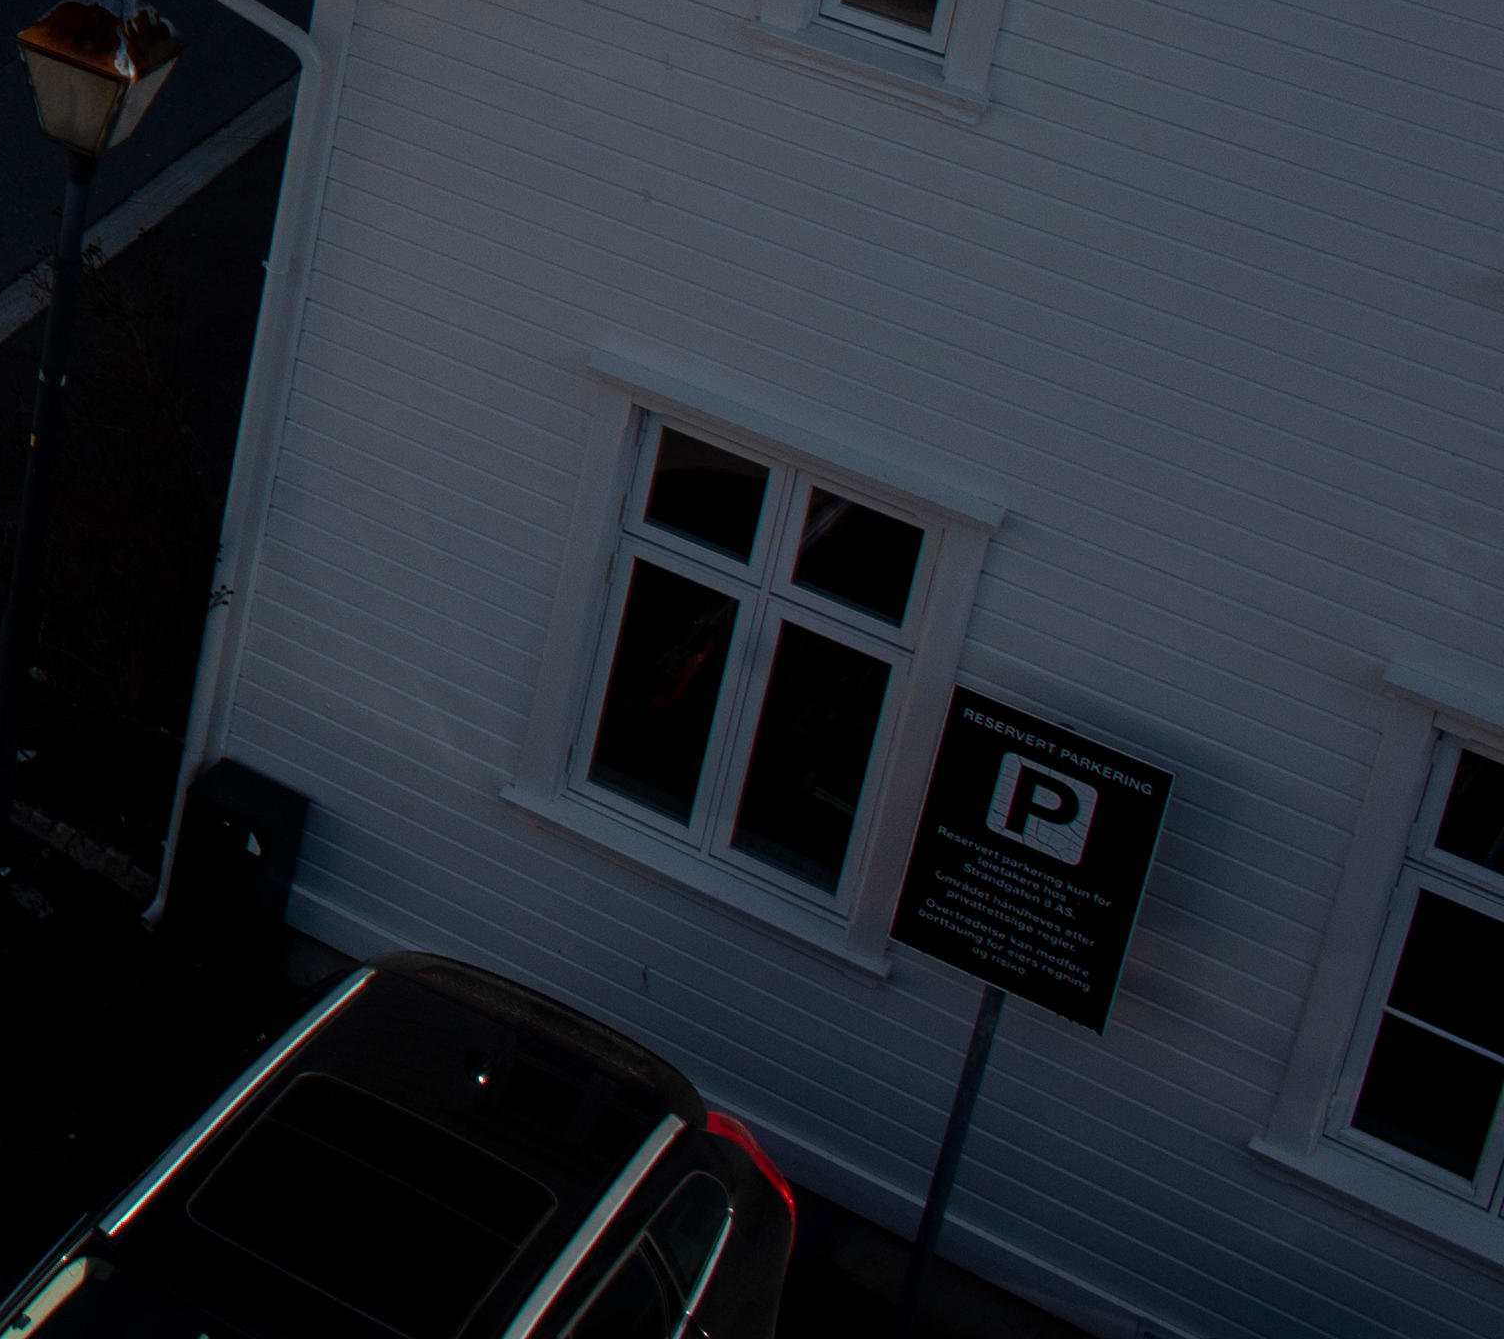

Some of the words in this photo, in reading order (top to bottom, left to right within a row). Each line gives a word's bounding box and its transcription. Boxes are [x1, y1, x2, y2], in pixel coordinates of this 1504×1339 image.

[962, 707, 1057, 754] RESERVERT
[1059, 747, 1154, 796] PARKERING
[1005, 763, 1080, 836] P
[937, 825, 999, 859] Reservert
[1001, 855, 1064, 889] parkering
[1066, 881, 1091, 900] kun
[963, 862, 1041, 904] Strandgaten
[977, 856, 1040, 890] leietakere
[1043, 884, 1067, 903] hos
[925, 898, 1006, 940] Overtredelse
[1009, 934, 1033, 953] kan
[935, 869, 990, 901] Området
[992, 894, 1061, 932] håndheves
[1064, 928, 1096, 947] etter
[946, 889, 1034, 933] privatrettslige
[918, 907, 984, 944] borttauing
[986, 937, 1004, 952] for
[1007, 948, 1039, 968] eiers
[1041, 963, 1091, 993] regning
[971, 946, 989, 960] og
